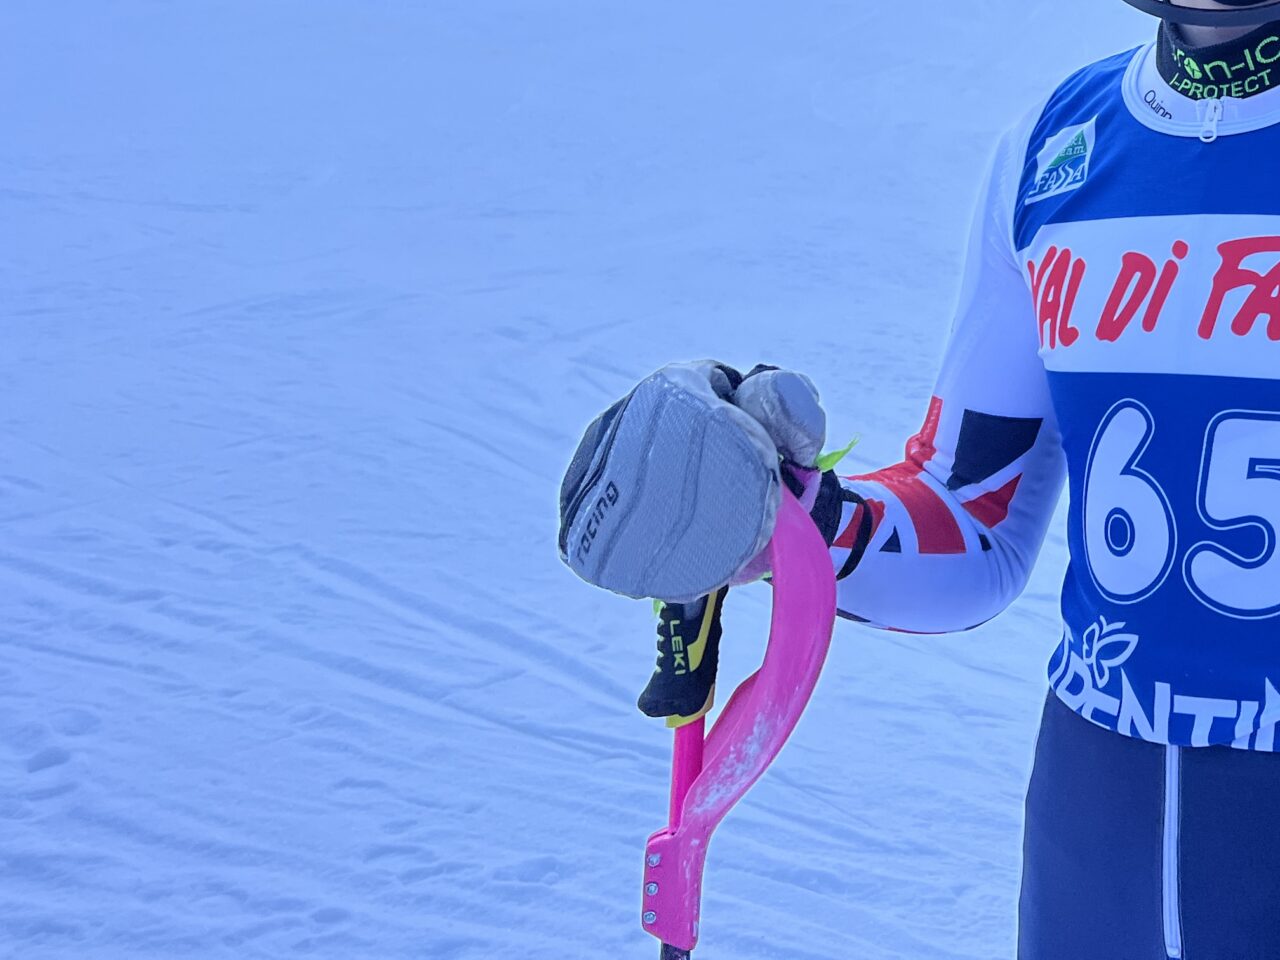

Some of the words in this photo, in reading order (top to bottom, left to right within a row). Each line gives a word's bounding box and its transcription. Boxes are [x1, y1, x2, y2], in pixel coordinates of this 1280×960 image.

[1029, 162, 1087, 195] FASSA
[1027, 245, 1087, 350] VAL
[669, 619, 687, 675] LEKI
